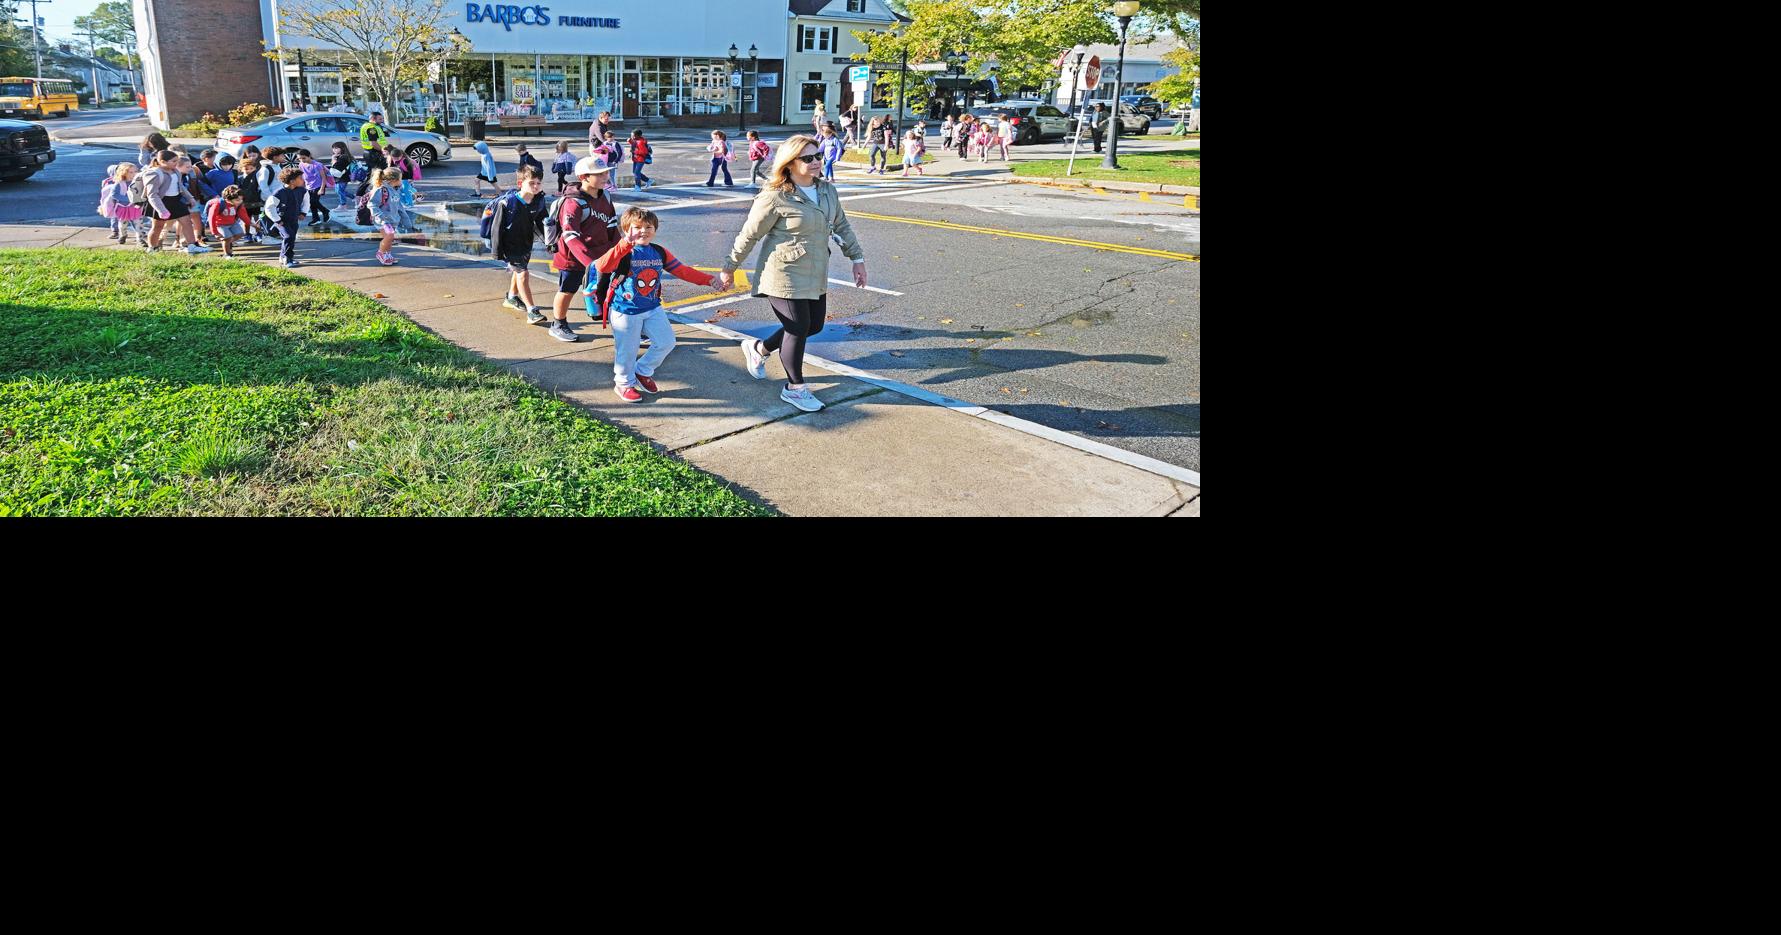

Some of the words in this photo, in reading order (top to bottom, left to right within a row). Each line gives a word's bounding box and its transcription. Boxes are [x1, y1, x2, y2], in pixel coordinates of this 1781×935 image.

[466, 3, 550, 32] BARBO'S
[557, 15, 620, 29] FURNITURE
[852, 68, 861, 81] P
[1086, 64, 1099, 80] STOP
